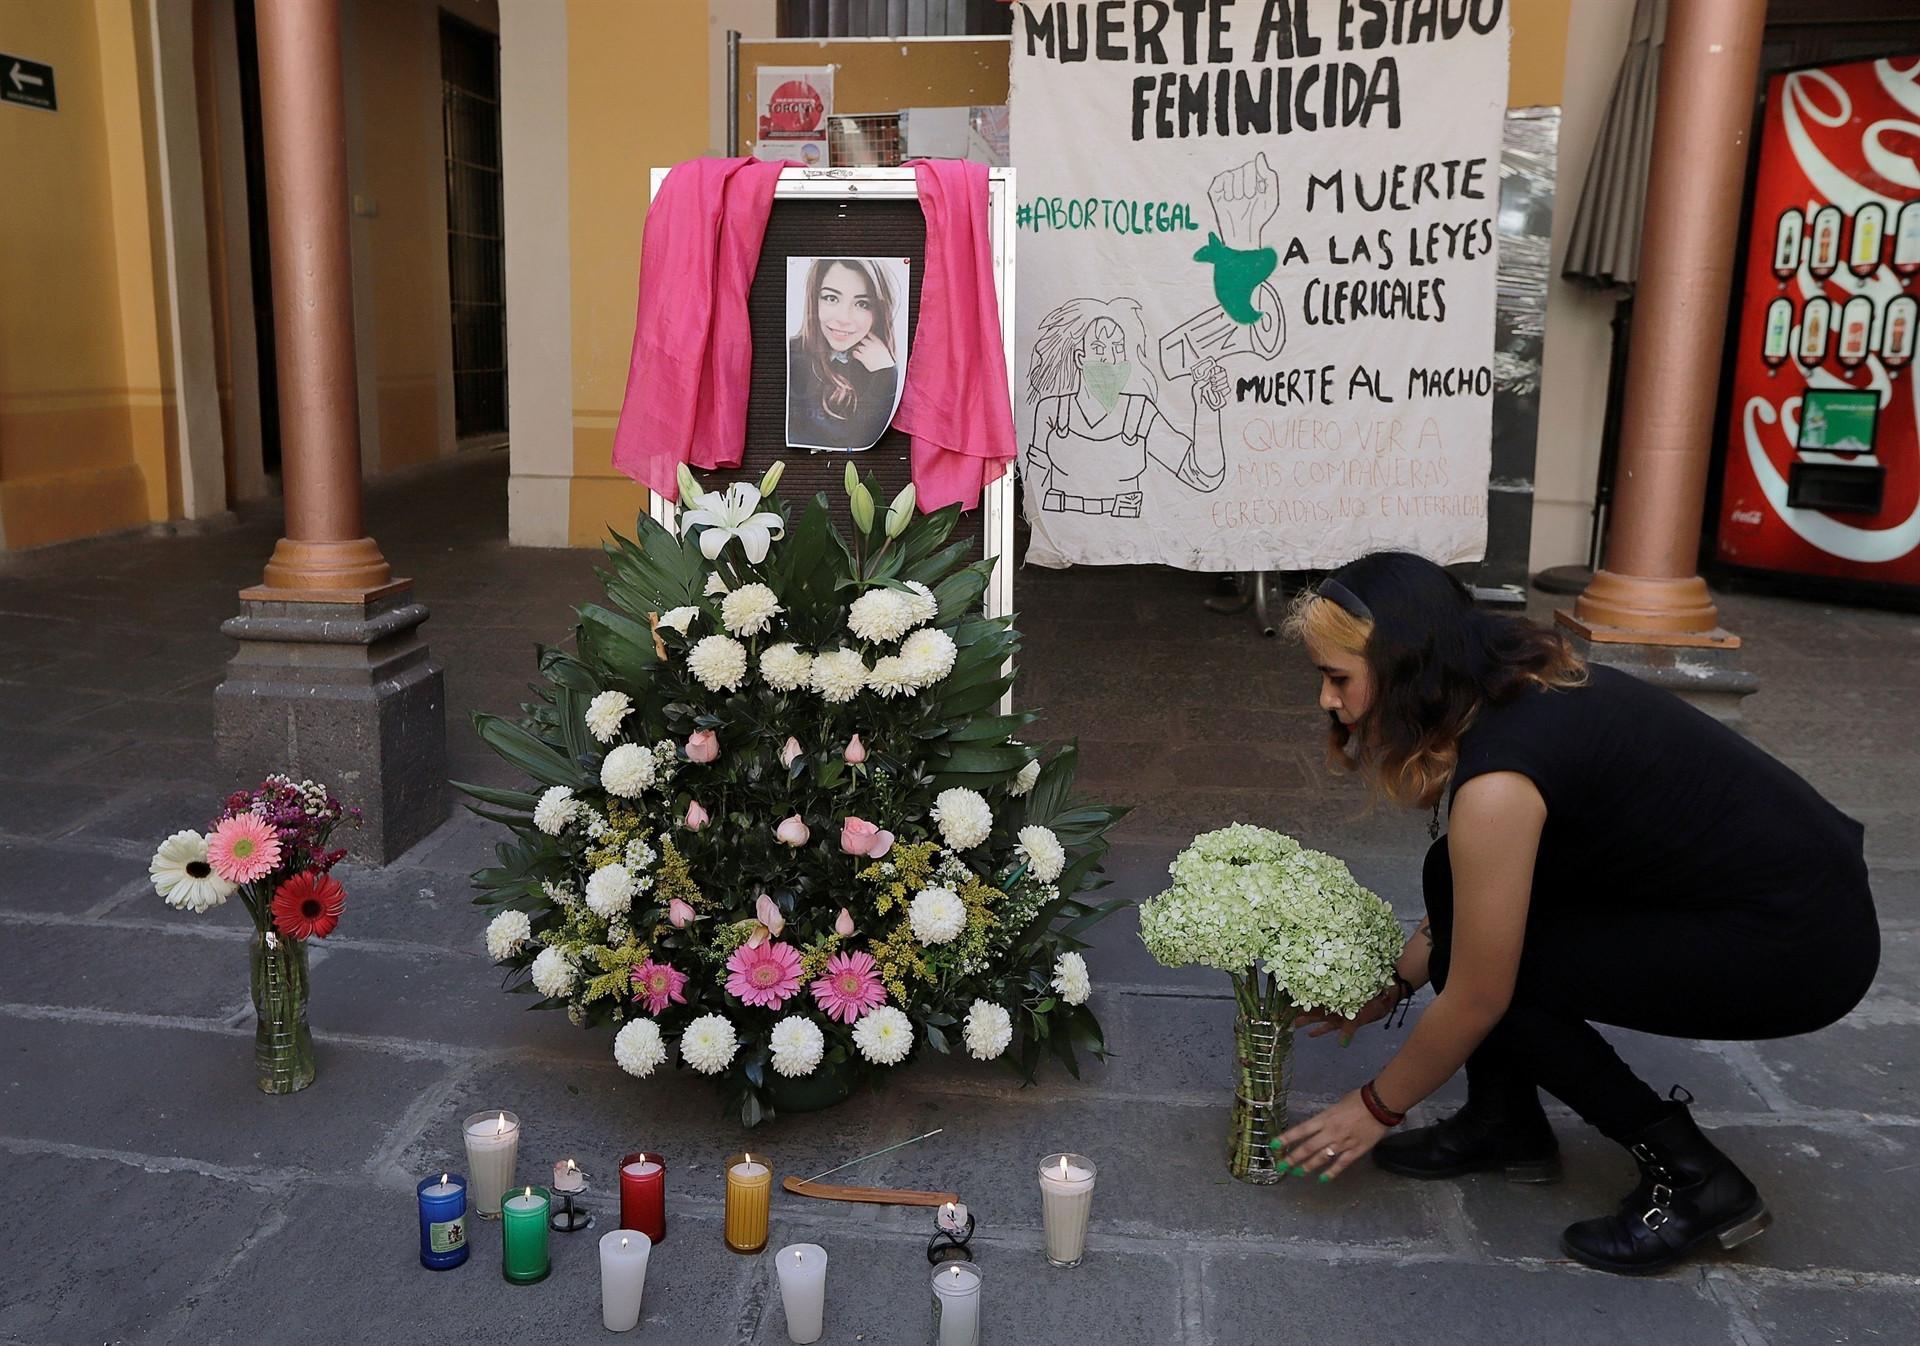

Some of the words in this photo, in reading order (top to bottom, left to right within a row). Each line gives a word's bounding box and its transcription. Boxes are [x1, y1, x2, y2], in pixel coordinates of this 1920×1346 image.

[1020, 0, 1235, 65] MUERTE
[1252, 0, 1322, 62] AL
[1338, 0, 1503, 51] ESTADO
[1132, 57, 1401, 141] FEMINICIDA
[1306, 158, 1487, 213] MUERTE
[1016, 197, 1199, 235] #ABORTOLEGAL
[1283, 237, 1309, 266] A
[1329, 229, 1393, 270] LAS
[1410, 218, 1492, 266] LEYES
[1303, 277, 1446, 325] CLERICALES
[1236, 365, 1335, 406] MUERTE
[1349, 365, 1393, 402] AL
[1408, 366, 1491, 400] MACHO
[1243, 417, 1342, 451] QUIERO
[1356, 420, 1405, 452] VER
[1418, 417, 1442, 449] A
[1237, 461, 1281, 487] MIS
[1293, 455, 1449, 488] COMPAÑERAS
[1339, 496, 1367, 517] NO
